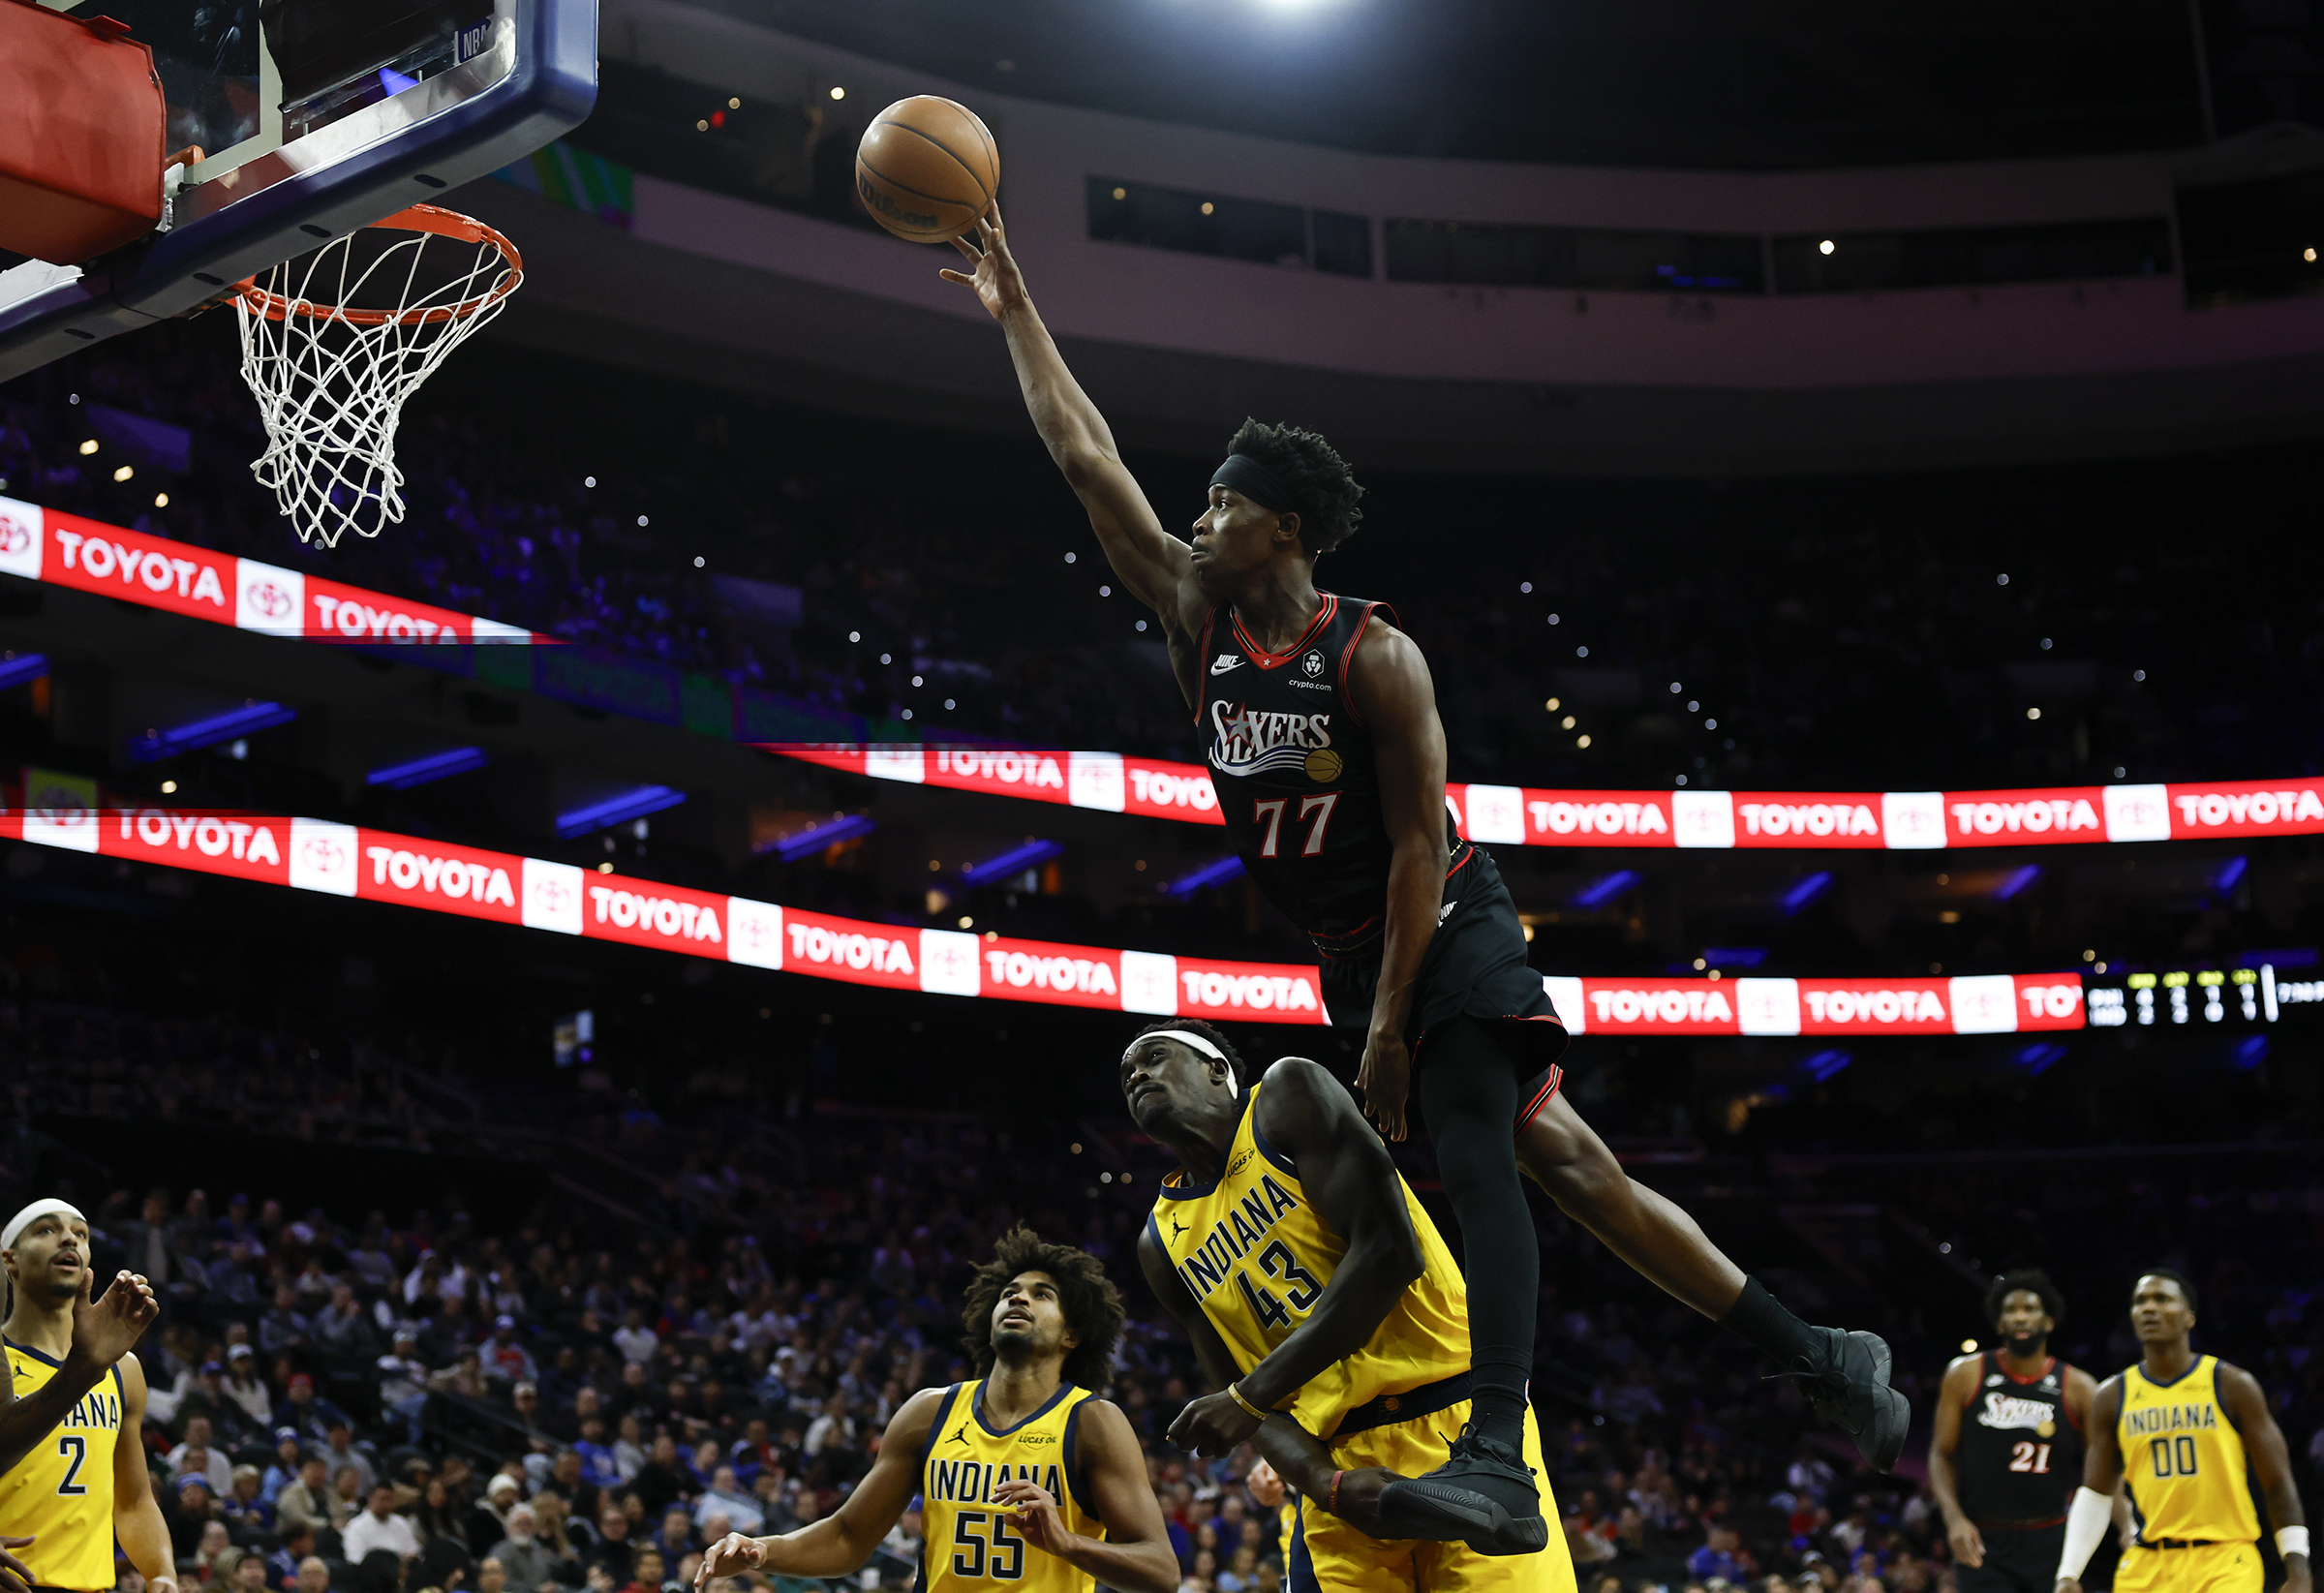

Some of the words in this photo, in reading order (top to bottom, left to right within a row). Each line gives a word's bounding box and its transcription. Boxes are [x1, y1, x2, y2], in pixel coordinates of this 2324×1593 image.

[55, 529, 226, 605] TOYOTA
[1215, 654, 1239, 668] NIKE
[1288, 678, 1332, 692] crypto.com
[1128, 768, 1218, 811] TOYO
[2175, 790, 2324, 827] TOYOTA
[114, 808, 281, 866] TOYOTA
[1253, 790, 1343, 859] 77
[1527, 800, 1668, 835] TOYOTA
[1739, 803, 1879, 837] TOYOTA
[1950, 799, 2099, 835] TOYOTA
[366, 845, 515, 907] TOYOTA
[589, 885, 722, 943] TOYOTA
[786, 922, 915, 975] TOYOTA
[986, 950, 1117, 996] TOYOTA
[1179, 970, 1318, 1012] TOYOTA
[1588, 989, 1733, 1024] TOYOTA
[1803, 990, 1946, 1024] TOYOTA
[1227, 1155, 1247, 1179] LUCAS
[1177, 1173, 1299, 1304] INDIANA
[1236, 1239, 1325, 1331] 43
[1019, 1434, 1043, 1444] LUCAS
[2124, 1402, 2217, 1438] INDIANA
[56, 1435, 87, 1496] 2
[2008, 1440, 2051, 1474] 21
[2151, 1435, 2199, 1481] 00
[952, 1510, 1025, 1580] 55
